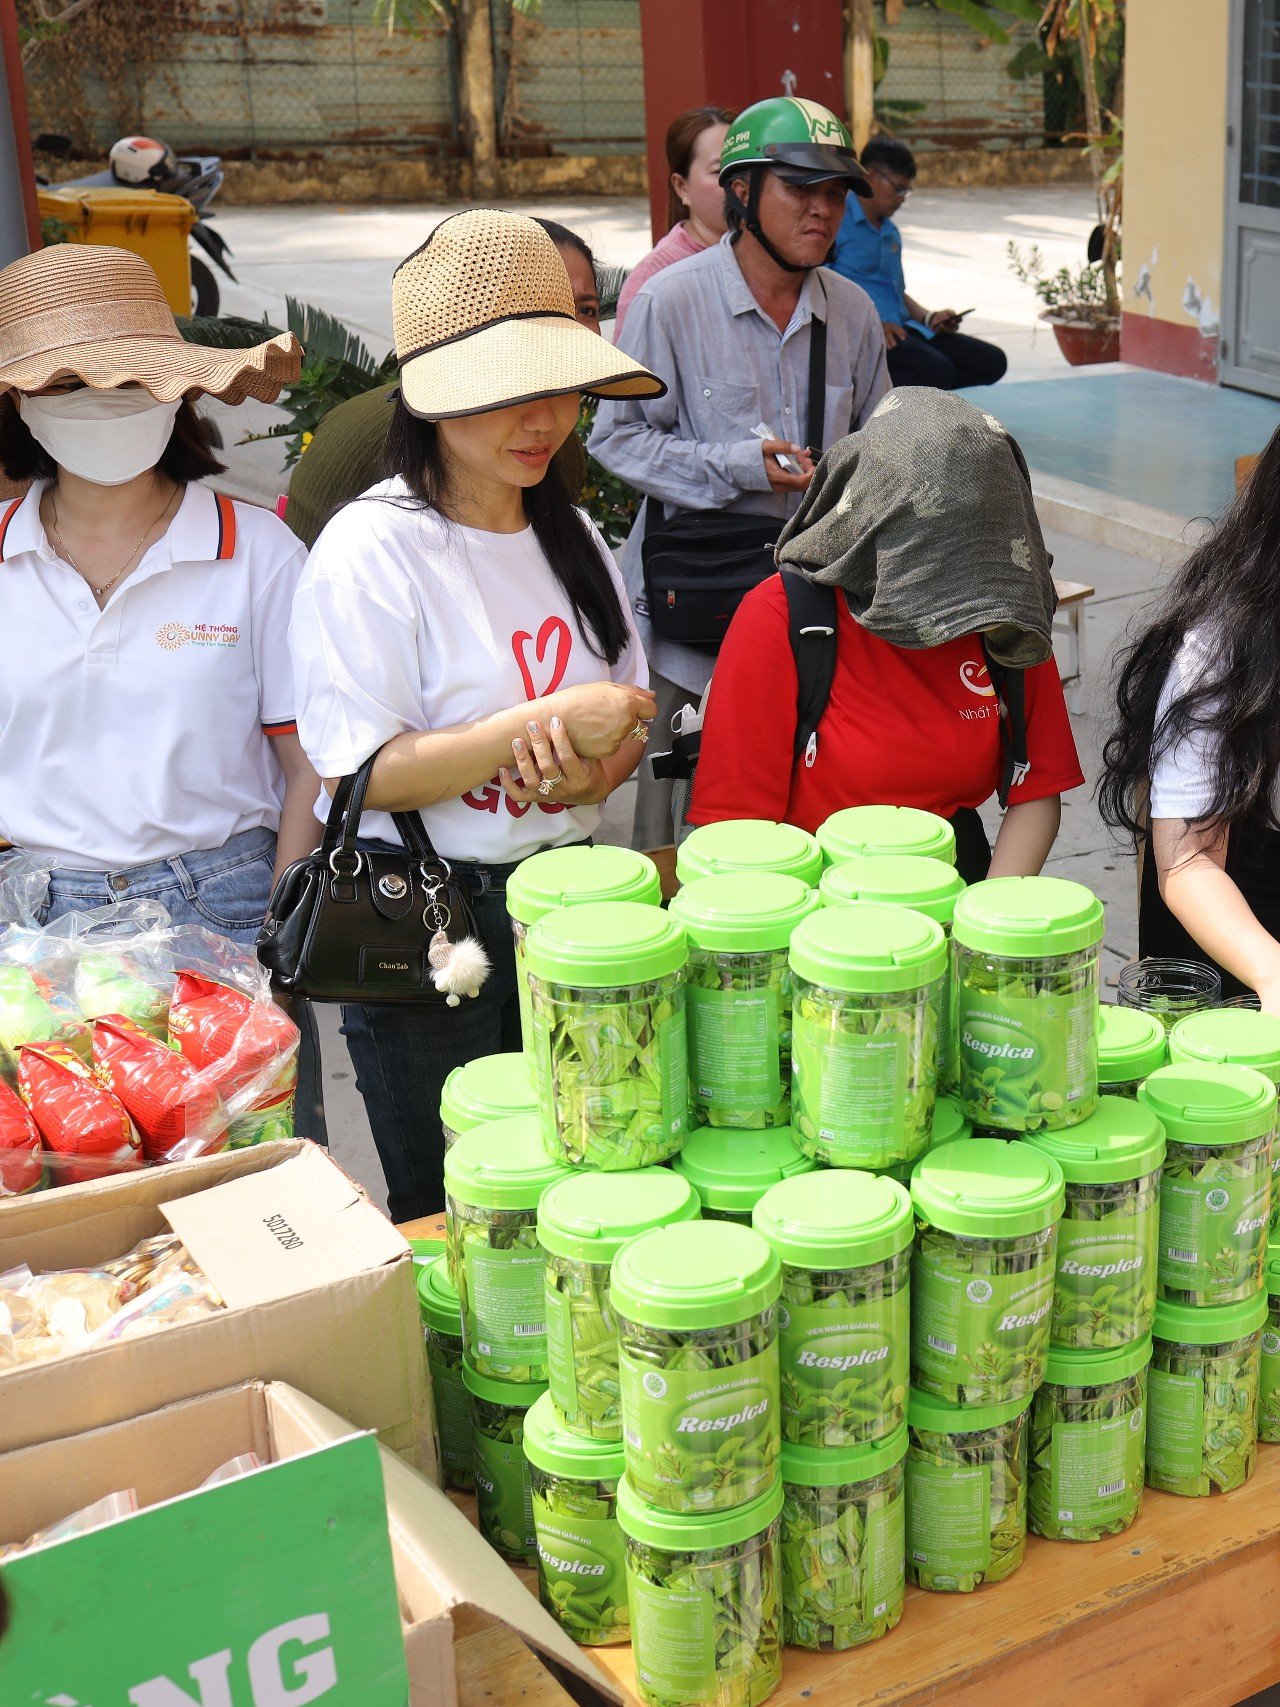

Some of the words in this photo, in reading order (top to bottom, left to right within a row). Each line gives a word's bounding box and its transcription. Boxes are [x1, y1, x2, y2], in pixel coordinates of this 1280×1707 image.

[184, 632, 219, 641] SUNNY
[222, 634, 241, 642] DAY
[195, 624, 206, 632] HỆ
[209, 624, 238, 633] THỐNG
[959, 706, 990, 720] Nhất
[962, 1031, 1034, 1059] Respica
[262, 1213, 304, 1250] 5017280
[1060, 1256, 1142, 1279] Respica
[797, 1346, 889, 1371] Respica
[676, 1399, 768, 1433] Respica
